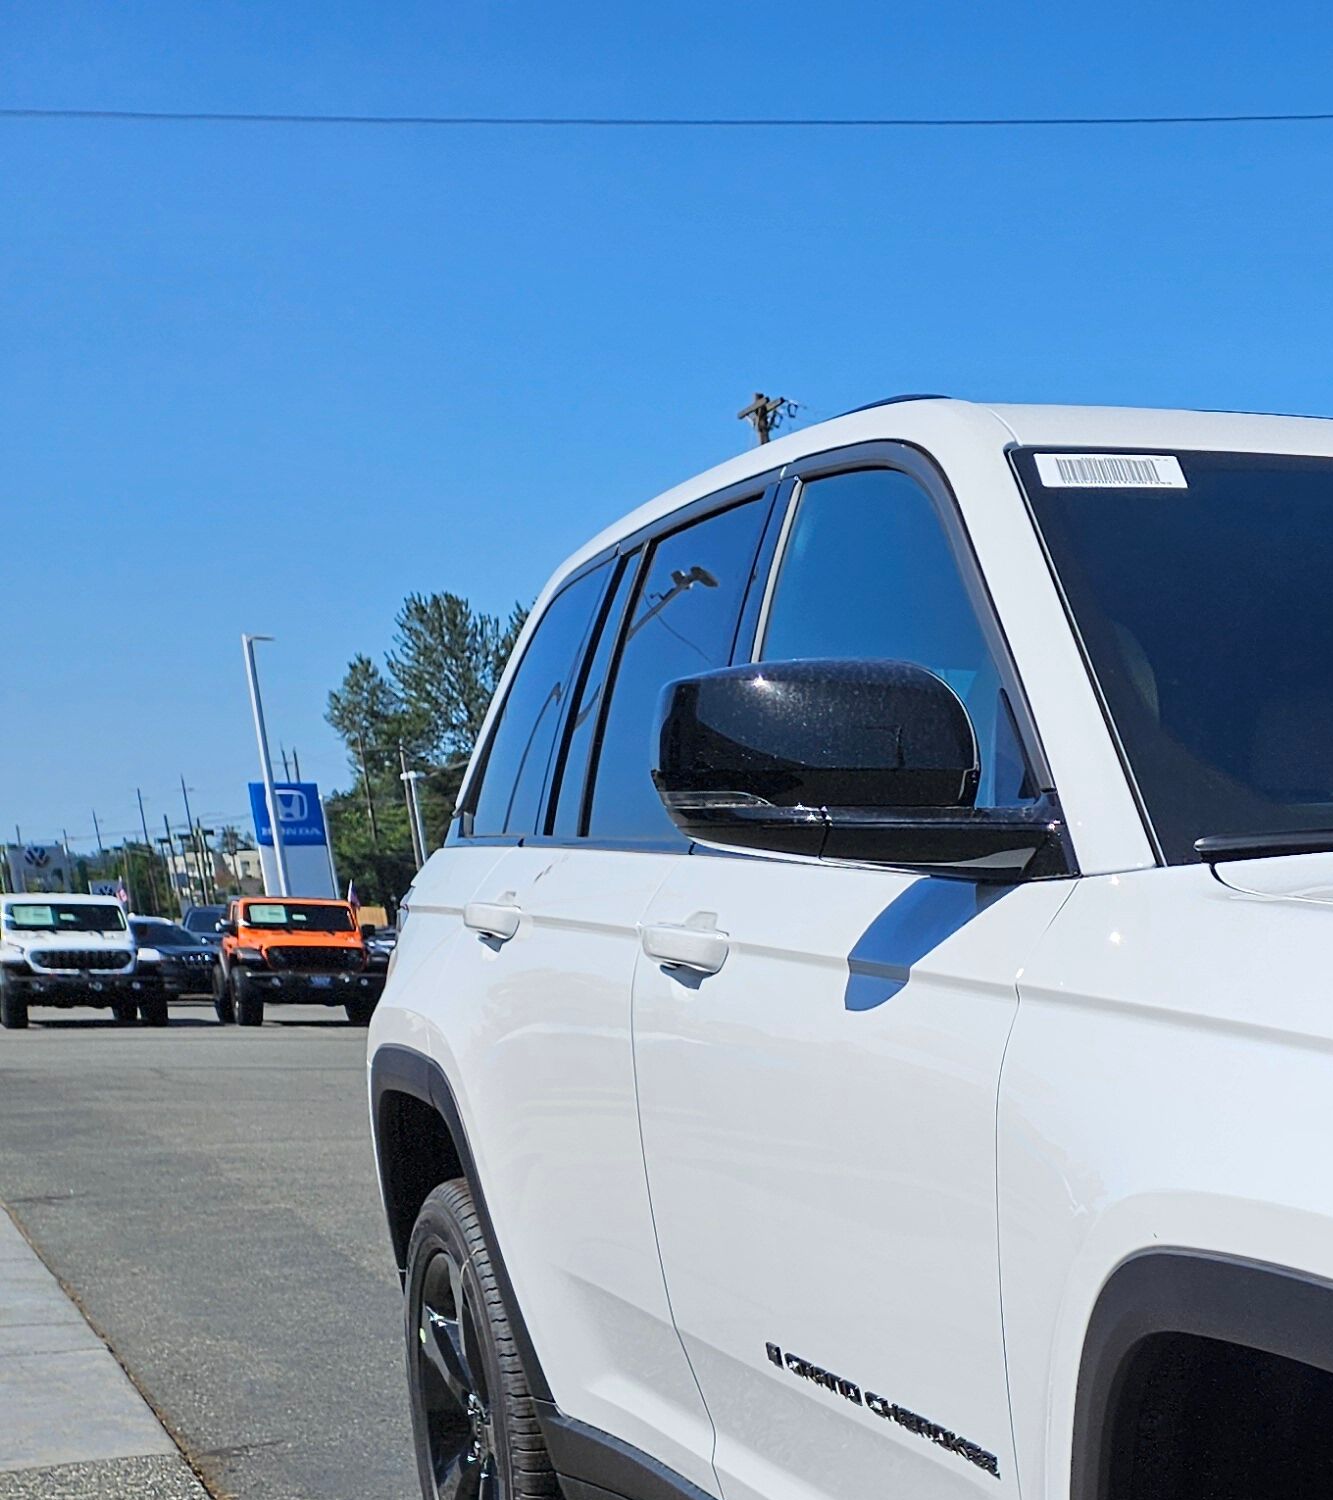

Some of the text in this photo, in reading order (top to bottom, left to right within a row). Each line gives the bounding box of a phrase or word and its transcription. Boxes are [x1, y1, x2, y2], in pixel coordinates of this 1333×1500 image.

[261, 826, 322, 836] HNDA
[784, 1352, 1001, 1480] GRAND CHEROKEE
